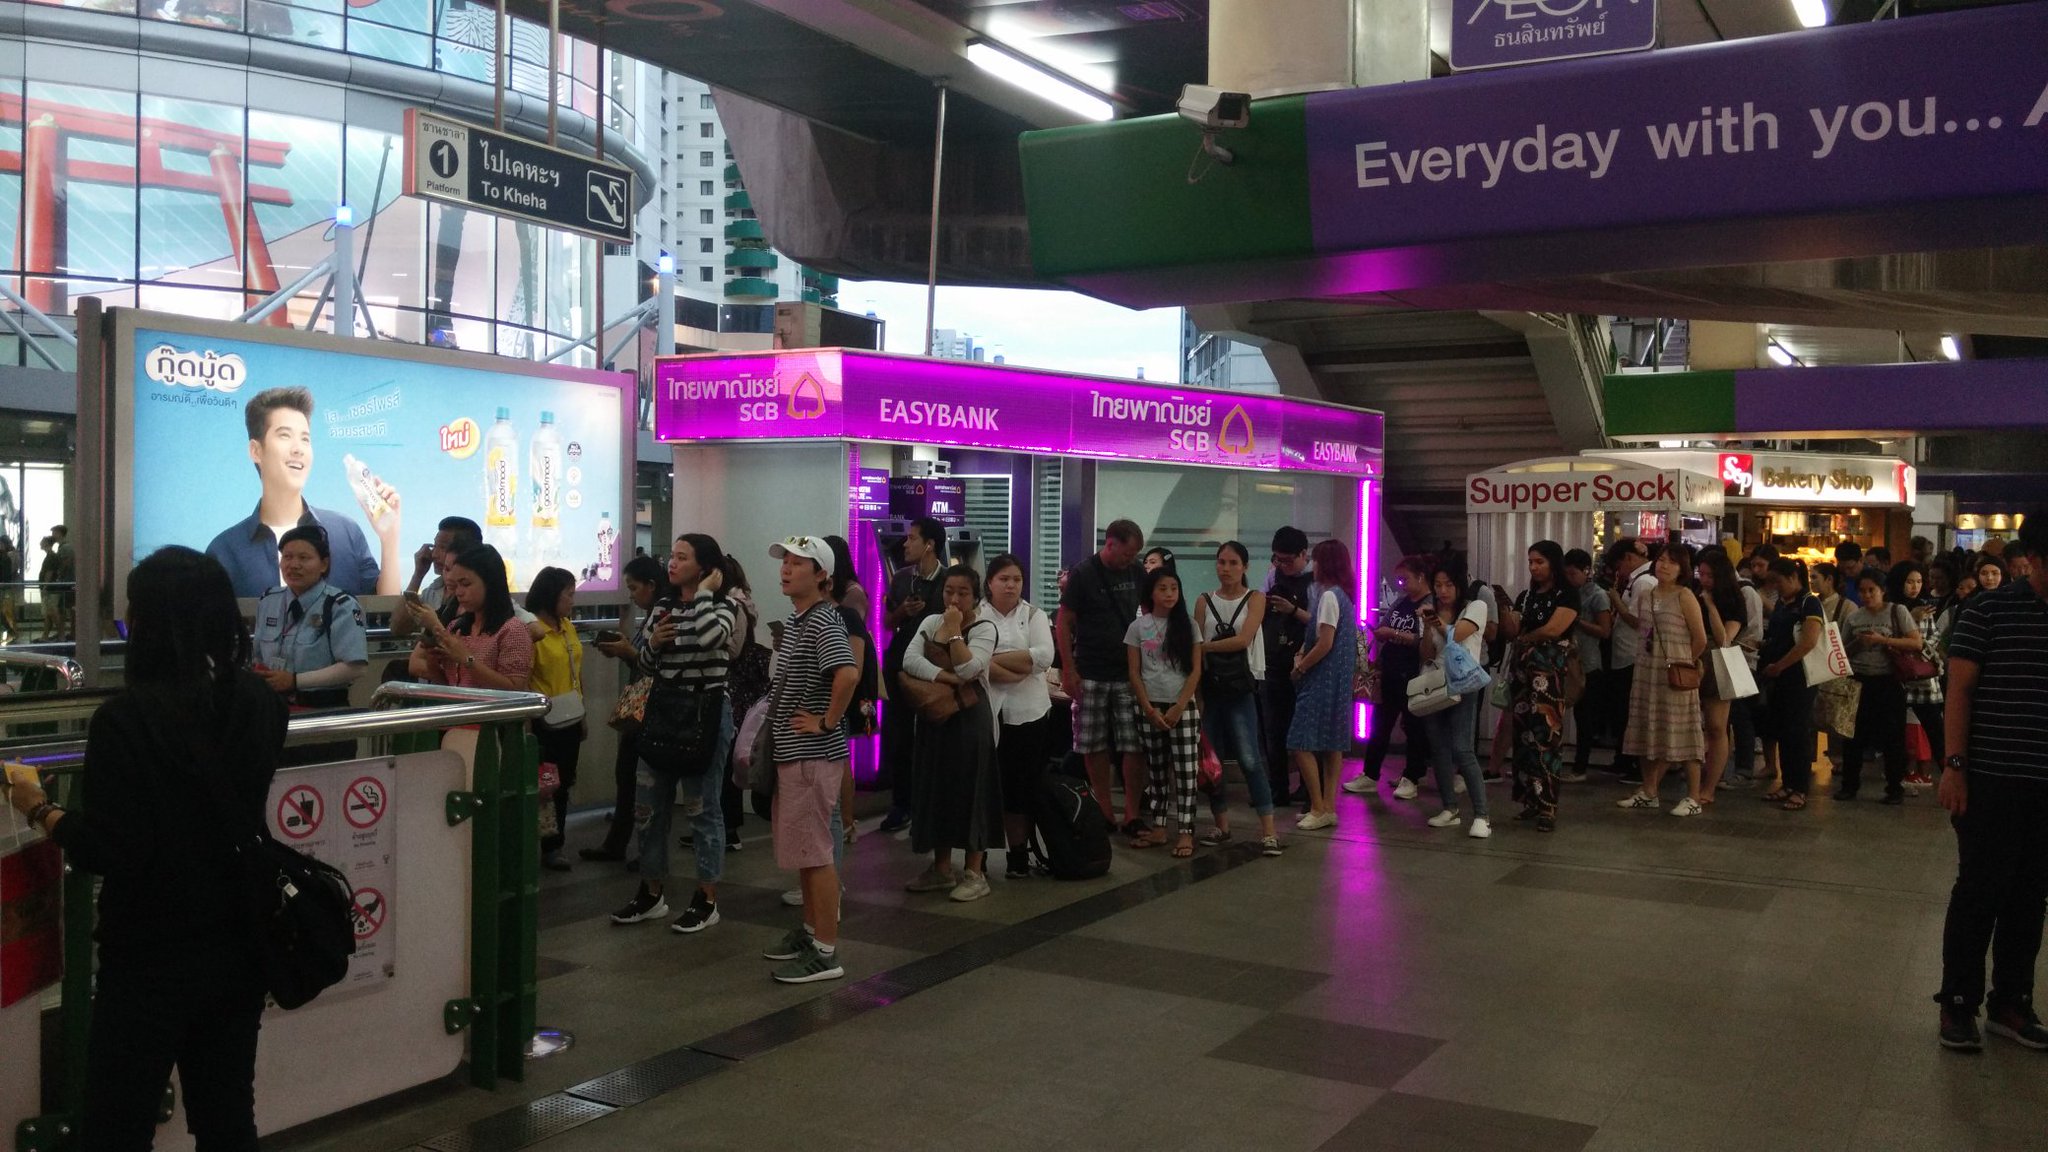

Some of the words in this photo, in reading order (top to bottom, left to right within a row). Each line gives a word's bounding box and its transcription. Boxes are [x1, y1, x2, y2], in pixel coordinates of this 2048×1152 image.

[1494, 11, 1608, 48] ธนสินทรัพย์
[422, 121, 466, 141] ชานชาลา
[1355, 122, 1619, 189] Everyday
[1646, 102, 1779, 160] with
[1809, 96, 2002, 160] you...
[437, 145, 450, 175] 1
[479, 138, 560, 188] ไปเคหะฯ
[426, 180, 461, 196] Platform
[481, 180, 500, 200] To
[503, 186, 547, 210] Kheha
[157, 347, 236, 387] กู๊ดมู้ด
[667, 371, 780, 400] ไทยพาณิชย์
[739, 402, 780, 422] SCB
[880, 398, 1000, 432] EASYBANK
[1090, 390, 1212, 427] ไทยพาณิชย์
[439, 421, 471, 451] ใหม่
[1169, 429, 1210, 452] SCB
[1313, 441, 1358, 463] EASYBANK
[1470, 474, 1588, 511] Supper
[1592, 473, 1676, 504] Sock
[1761, 466, 1826, 495] Bakery
[1829, 467, 1874, 496] Shop
[931, 501, 948, 514] ATM
